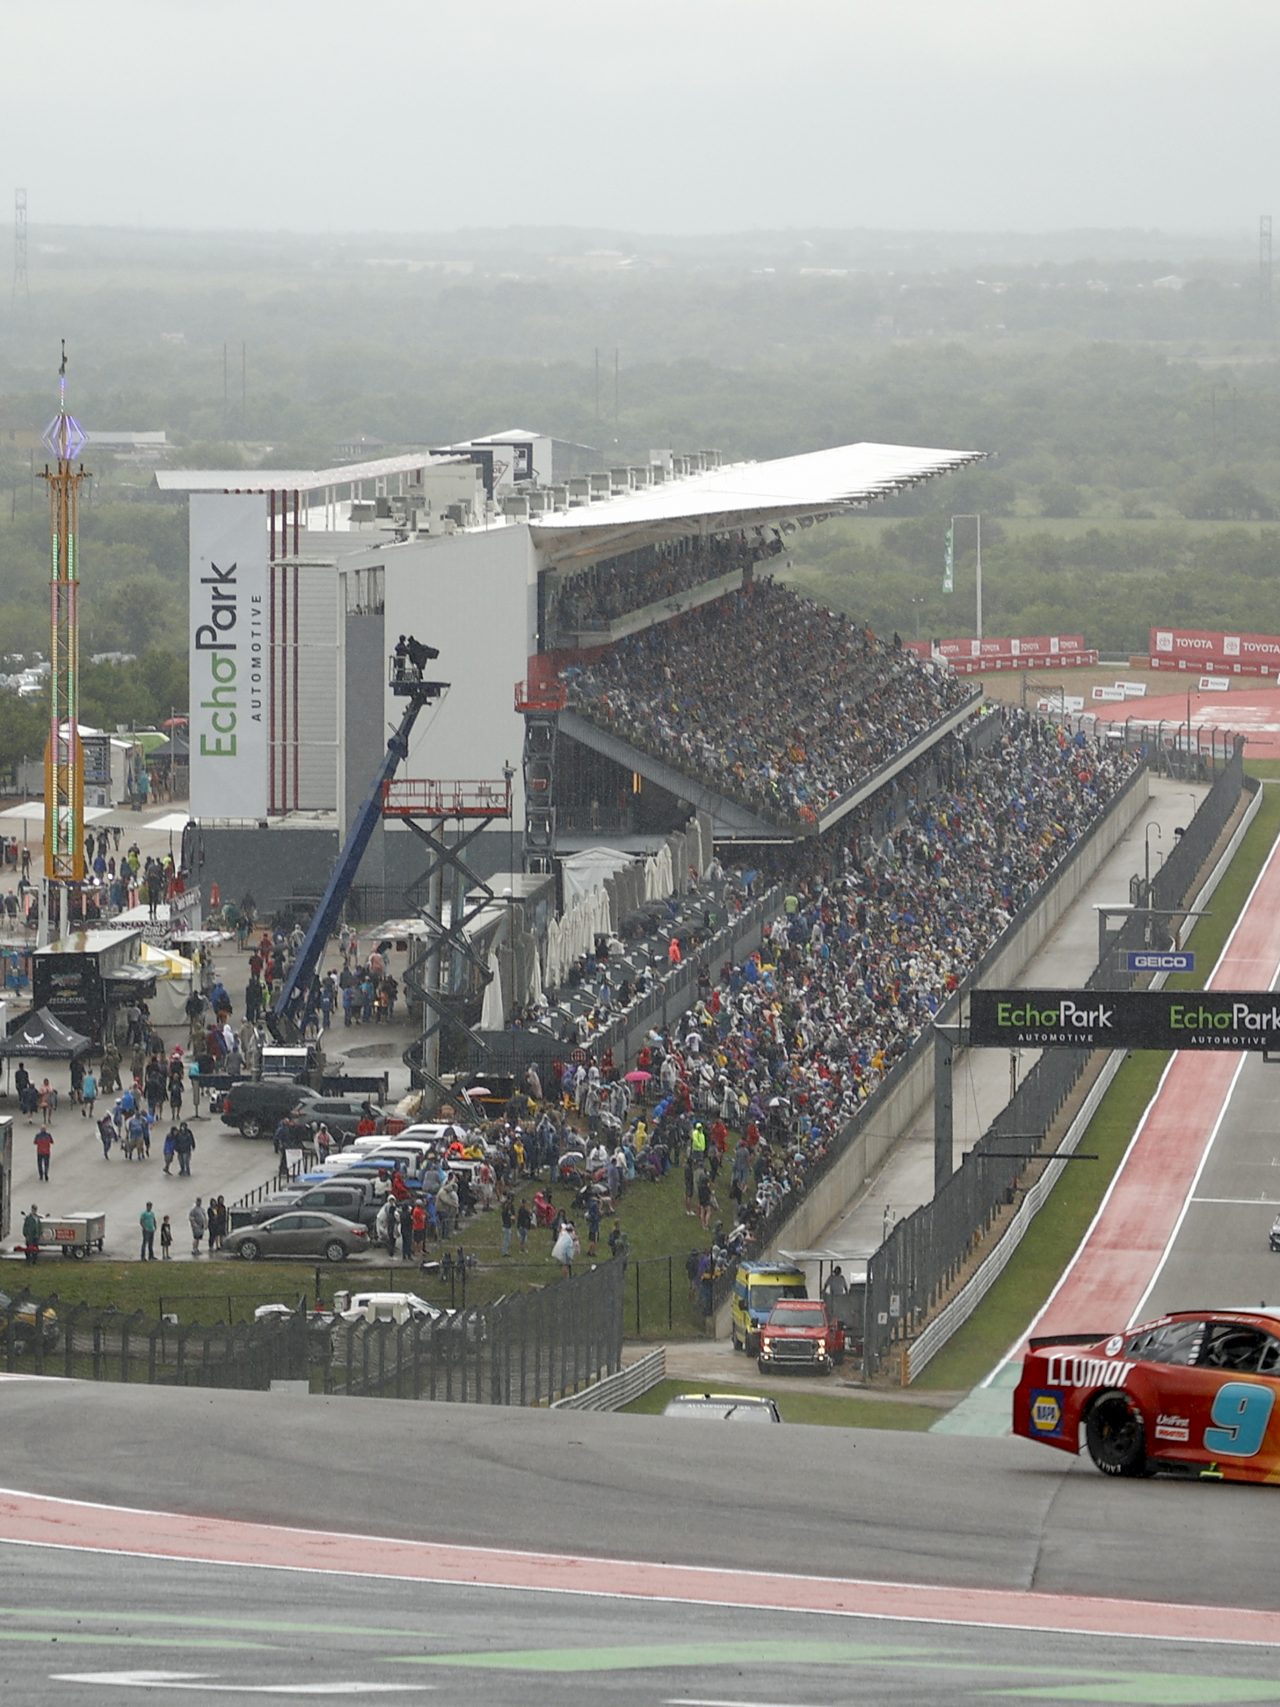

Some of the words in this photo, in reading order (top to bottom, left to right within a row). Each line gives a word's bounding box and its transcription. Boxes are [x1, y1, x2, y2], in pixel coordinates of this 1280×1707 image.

[1176, 638, 1213, 649] TOYOTA
[1243, 642, 1280, 654] TOYOTA
[195, 562, 237, 756] EchoPark
[251, 595, 262, 722] AUTOMOTIVE
[1134, 956, 1187, 968] GEICO
[998, 1001, 1113, 1028] EchoPark
[1018, 1033, 1094, 1042] AUTOMOTIVE
[1191, 1036, 1267, 1045] AUTOMOTIVE
[1036, 1405, 1057, 1421] NAPA
[1203, 1381, 1276, 1458] 9
